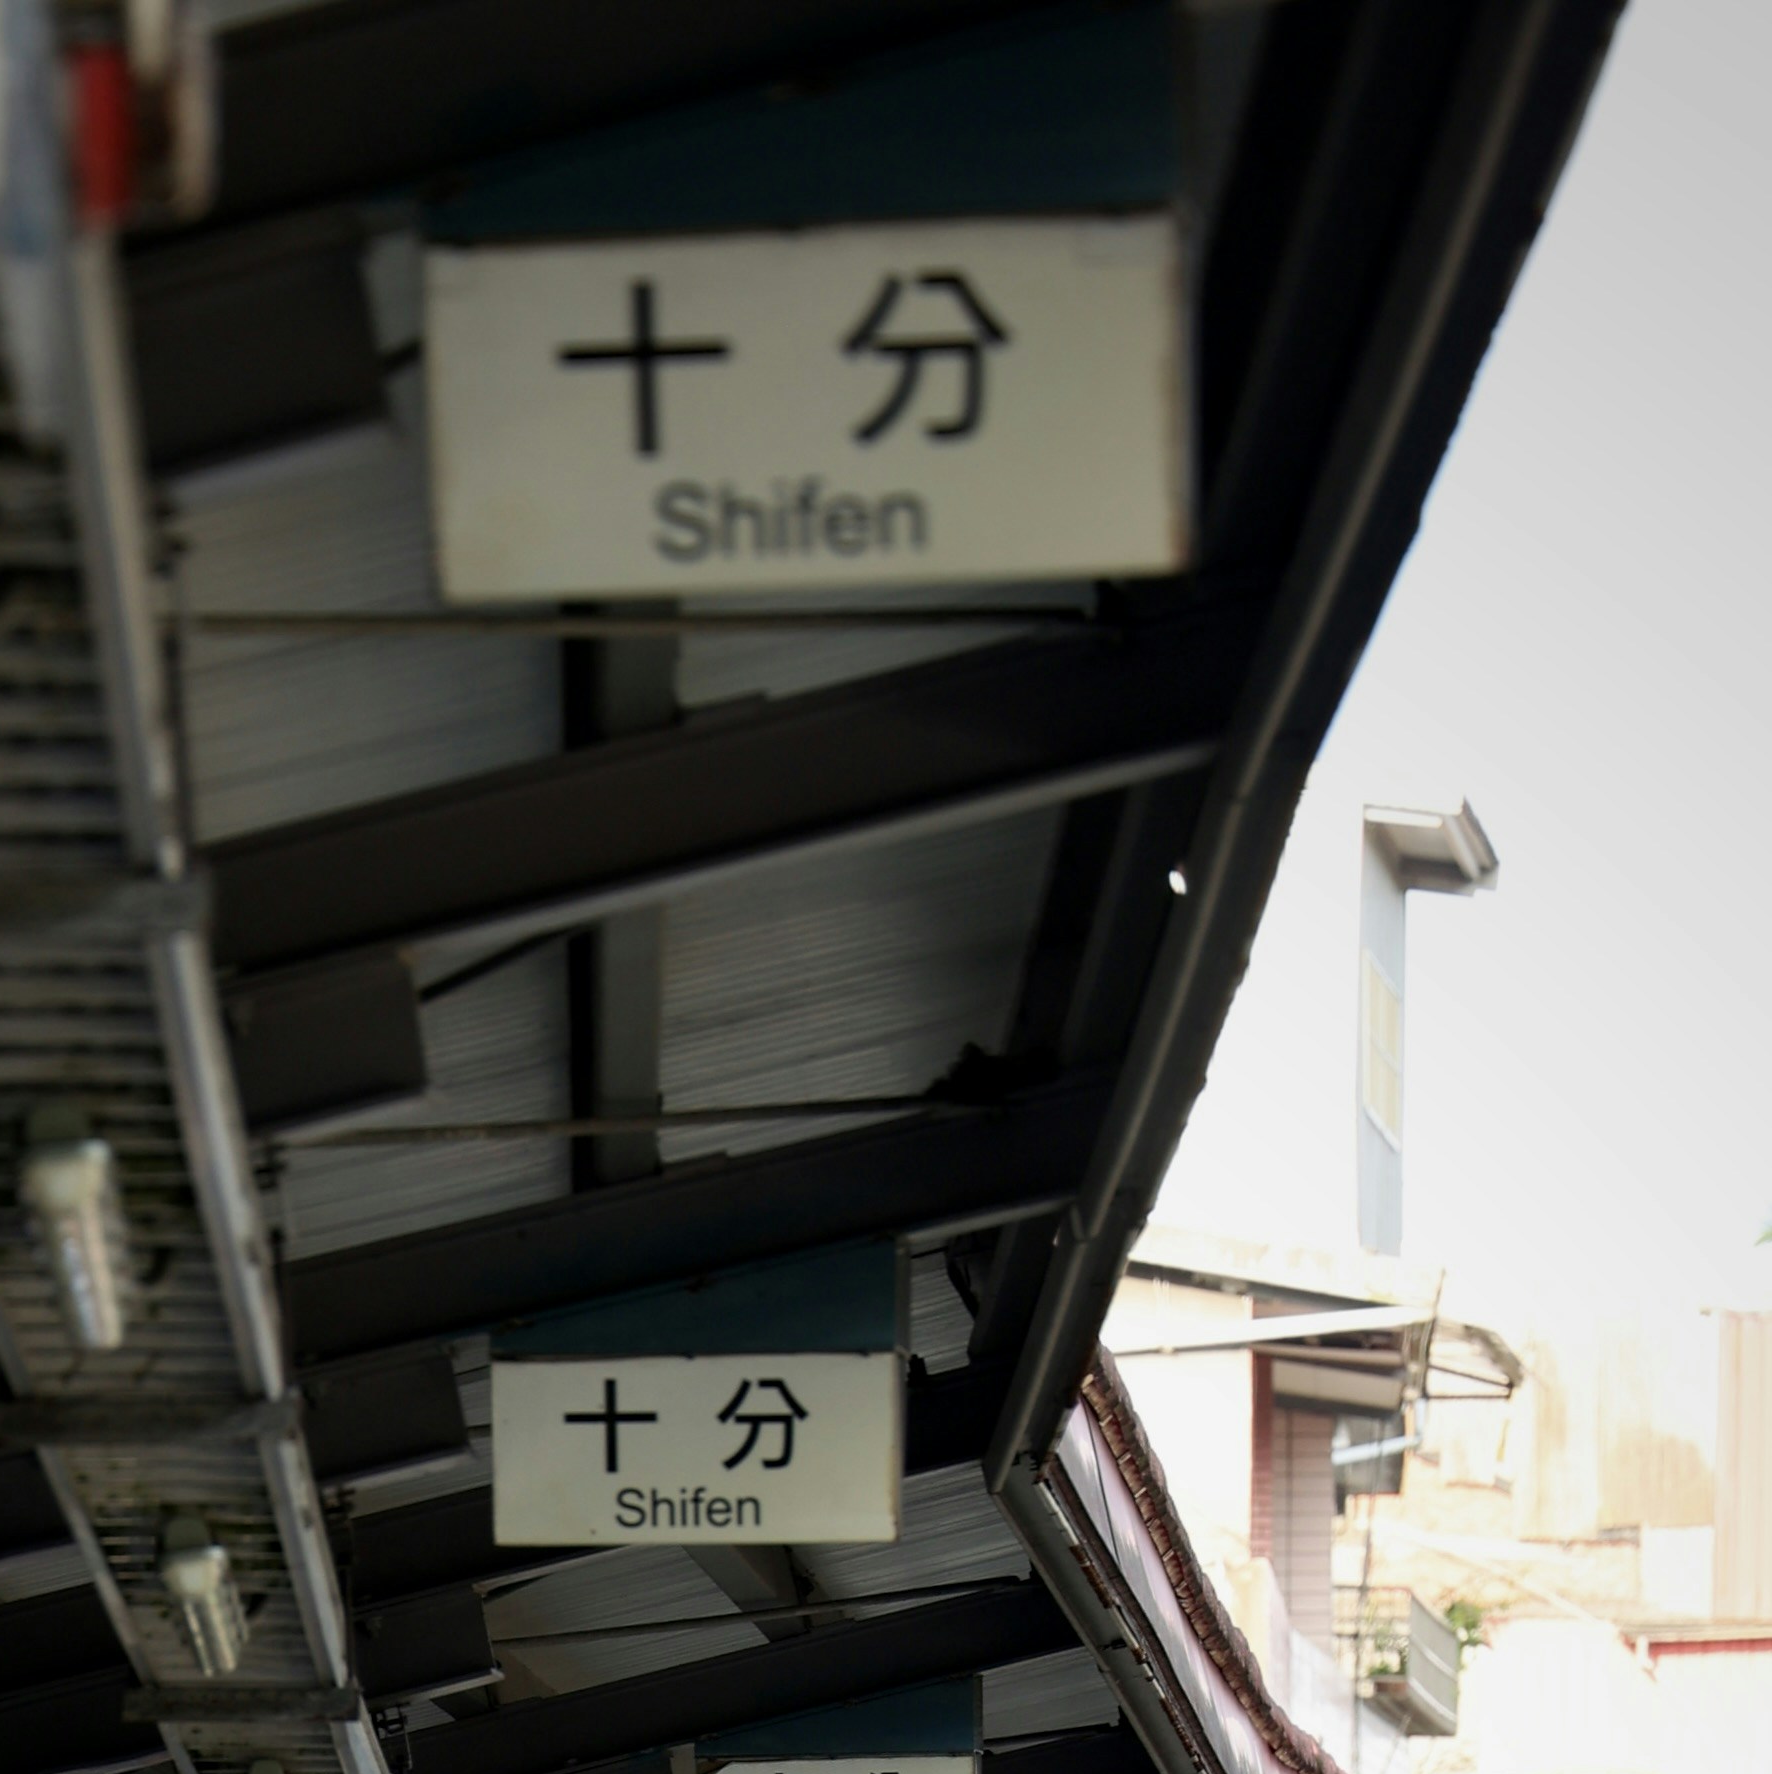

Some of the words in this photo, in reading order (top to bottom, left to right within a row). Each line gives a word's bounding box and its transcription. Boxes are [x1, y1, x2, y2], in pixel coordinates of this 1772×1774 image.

[555, 267, 1010, 459] 十分
[653, 477, 929, 563] Shifen
[564, 1377, 808, 1473] 十分
[614, 1487, 762, 1530] Shifen
